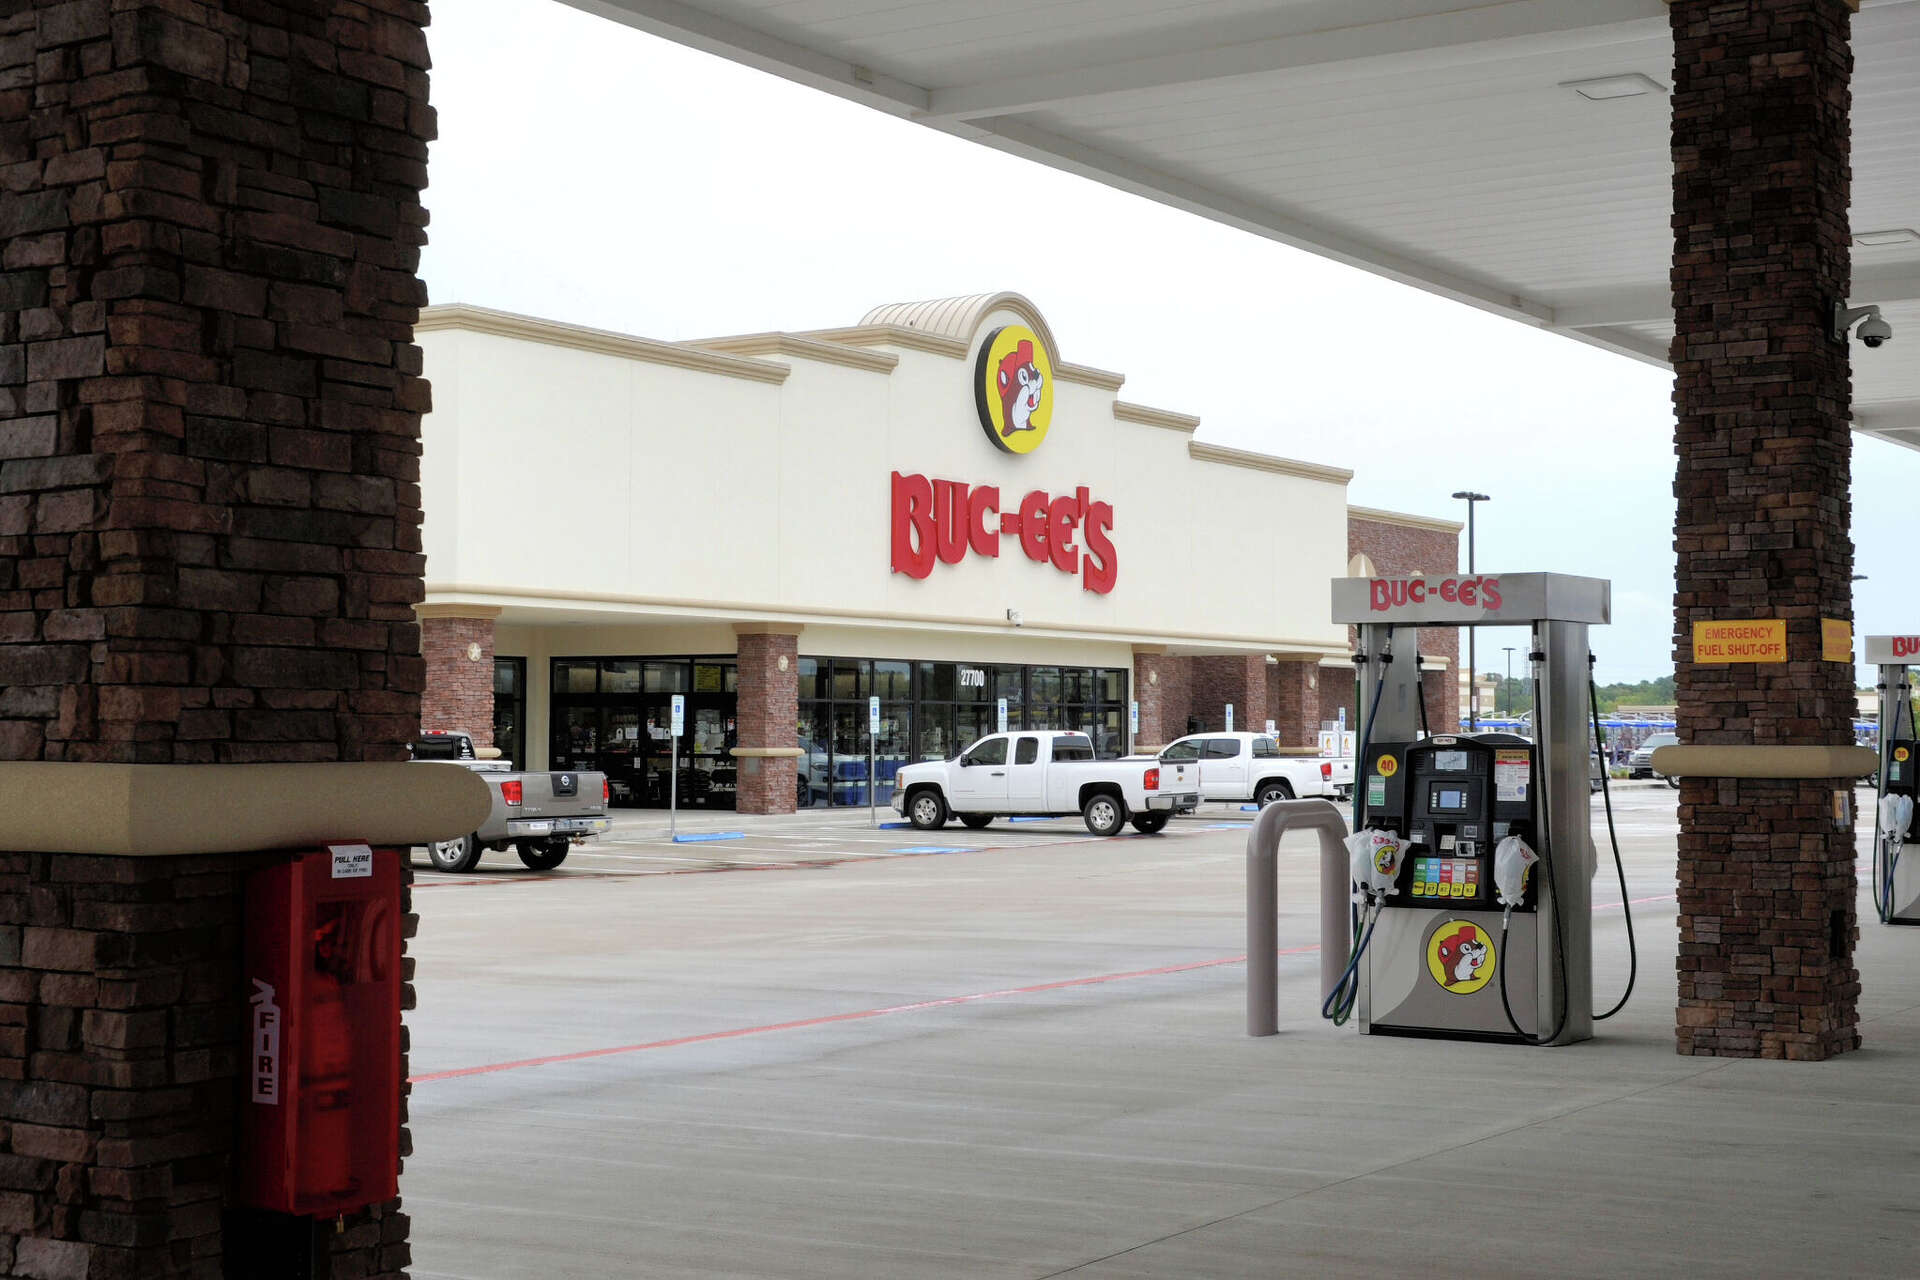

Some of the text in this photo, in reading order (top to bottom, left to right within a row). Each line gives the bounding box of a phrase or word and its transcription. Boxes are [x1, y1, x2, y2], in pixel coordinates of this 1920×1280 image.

[891, 470, 1117, 594] BUC-EE'S
[1370, 576, 1502, 611] BUC-EE'S
[1705, 627, 1773, 639] EMERGENCY
[1698, 643, 1780, 656] FUEL SHUT-OFF
[1892, 636, 1920, 657] BU
[960, 669, 985, 687] 27700
[1381, 760, 1394, 772] 40
[334, 855, 370, 864] PULL HERE
[258, 1011, 275, 1095] FIRE
